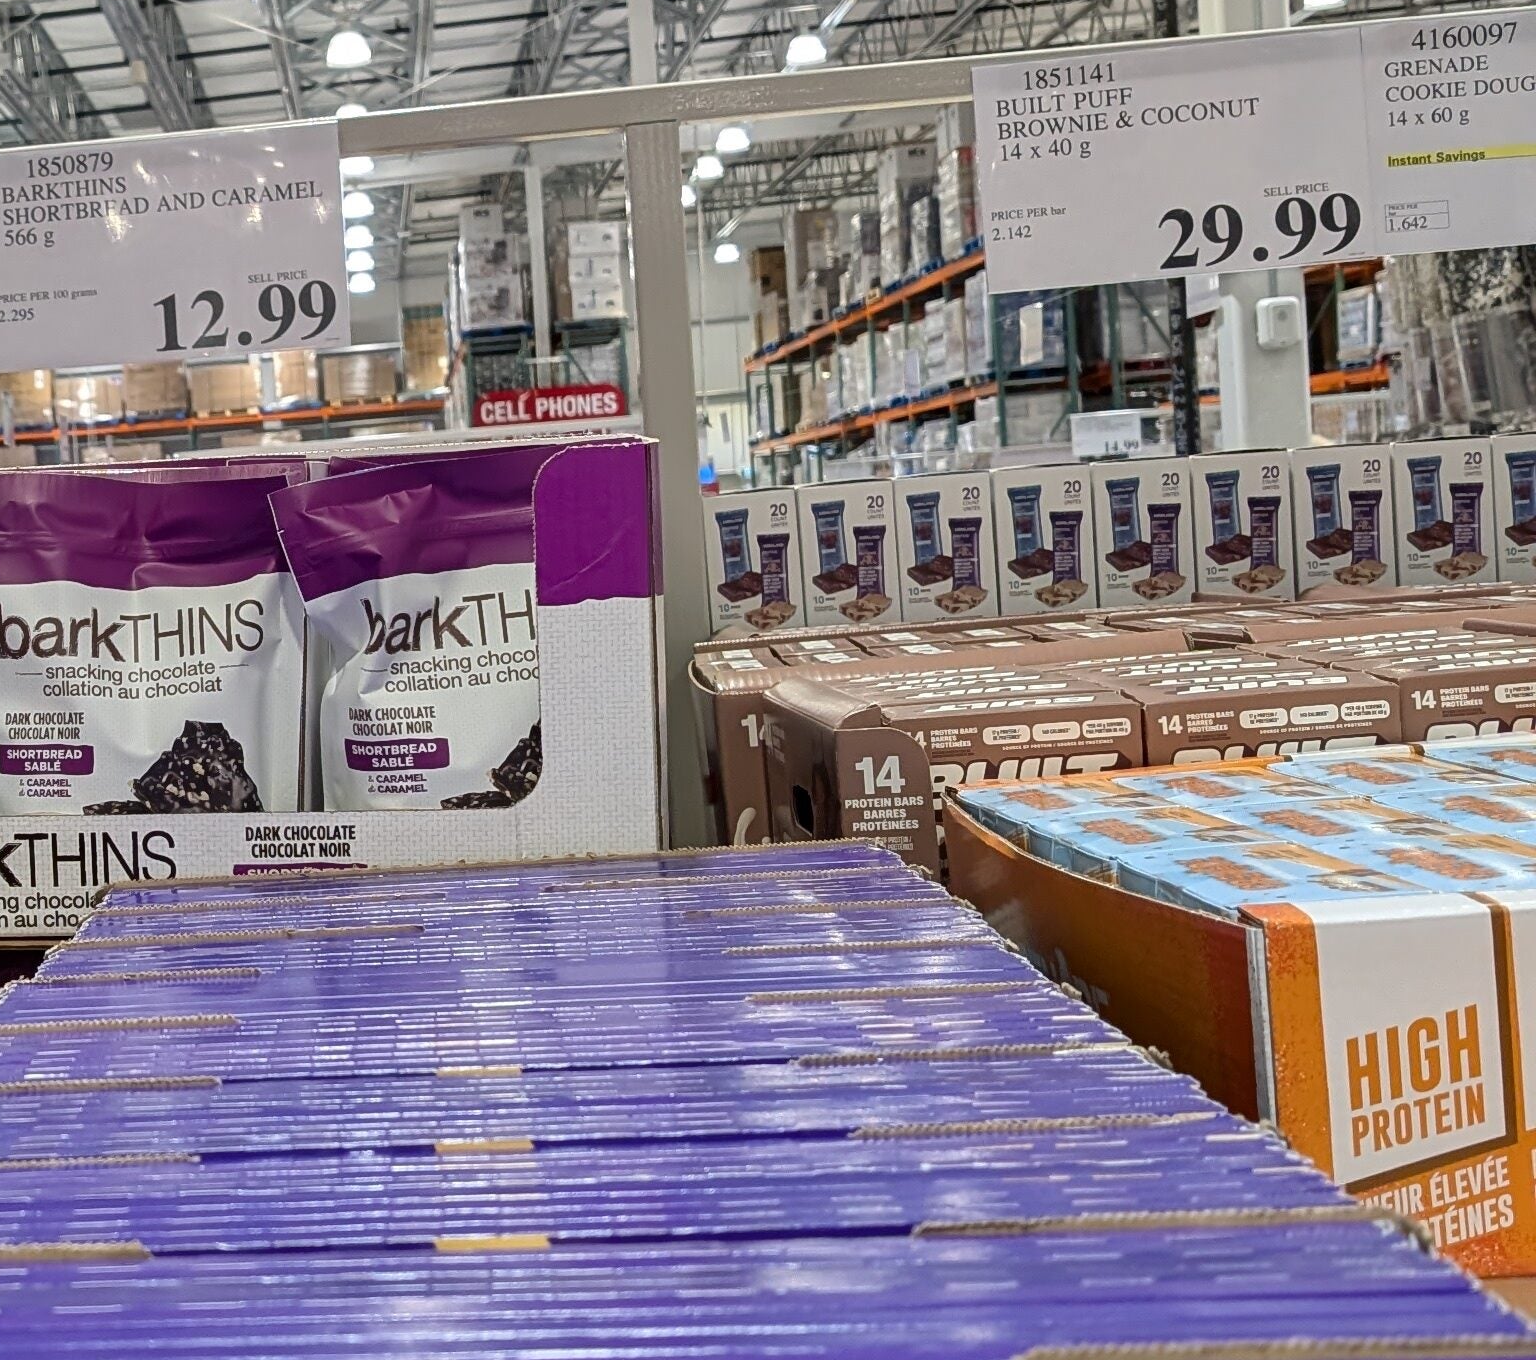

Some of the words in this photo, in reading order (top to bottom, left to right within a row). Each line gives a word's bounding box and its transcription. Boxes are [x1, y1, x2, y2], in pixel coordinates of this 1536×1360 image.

[1411, 21, 1517, 51] 4160097
[1384, 55, 1489, 78] GRENADE
[1023, 62, 1115, 91] 1851141
[1385, 81, 1467, 102] COOKIE
[996, 93, 1065, 118] BUILT
[1074, 87, 1133, 110] PUFF
[998, 113, 1109, 140] BROWNIE
[1115, 110, 1134, 129] &
[1141, 97, 1260, 126] COCONUT
[1388, 110, 1407, 127] 14
[1415, 113, 1424, 125] x
[1431, 106, 1453, 123] 60
[1459, 109, 1470, 125] g
[1000, 144, 1022, 162] 14
[1030, 145, 1041, 158] x
[1048, 138, 1072, 157] 40
[1080, 140, 1091, 158] g
[27, 152, 113, 178] 1850879
[1388, 154, 1432, 167] Instant
[1436, 150, 1486, 163] Savings
[1, 176, 127, 205] BARKTHINS
[157, 192, 205, 213] AND
[212, 180, 323, 208] CARAMEL
[1264, 185, 1292, 198] SELL
[1295, 182, 1329, 195] PRICE
[990, 210, 1024, 221] PRICE
[1026, 208, 1048, 219] PER
[1050, 205, 1066, 218] bar
[1158, 192, 1361, 269] 29.99
[1389, 216, 1427, 232] 1.642
[4, 227, 37, 247] 566
[44, 230, 55, 247] g
[991, 225, 1032, 241] 2.142
[248, 272, 273, 284] SELL
[276, 269, 307, 282] PRICE
[30, 291, 50, 302] PER
[52, 290, 69, 300] 100
[153, 280, 337, 352] 12.99
[480, 398, 532, 424] CELL
[535, 392, 619, 419] PHONES
[1363, 459, 1381, 473] 20
[1464, 452, 1482, 465] 20
[1162, 473, 1180, 486] 20
[1262, 465, 1280, 479] 20
[962, 487, 980, 500] 20
[1064, 480, 1081, 493] 20
[866, 495, 884, 508] 20
[770, 503, 787, 517] 20
[45, 663, 122, 685] snacking
[128, 660, 216, 683] chocolate
[390, 656, 471, 675] snacking
[43, 681, 113, 697] collation
[118, 686, 140, 699] au
[145, 676, 223, 699] chocolat
[385, 675, 462, 693] collation
[468, 673, 490, 686] au
[1411, 689, 1437, 710] 14
[5, 713, 31, 726] DARK
[33, 712, 84, 725] CHOCOLATE
[349, 707, 372, 722] DARK
[375, 706, 436, 721] CHOCOLATE
[353, 722, 402, 736] CHOCOLAT
[406, 721, 433, 734] NOIR
[1157, 715, 1183, 735] 14
[8, 727, 55, 740] CHOCOLAT
[57, 727, 80, 740] NOIR
[7, 749, 82, 760] SHORTBREAD
[352, 743, 437, 756] SHORTBREAD
[24, 760, 61, 772] SABLÉ
[26, 778, 71, 787] CARAMEL
[376, 773, 427, 783] CARAMEL
[855, 755, 906, 795] 14
[26, 789, 71, 797] CARAMEL
[377, 785, 427, 793] CARAMEL
[844, 798, 891, 809] PROTEIN
[894, 796, 924, 806] BARS
[864, 809, 906, 819] BARRES
[245, 826, 281, 841] DARK
[284, 825, 356, 840] CHOCOLATE
[251, 843, 315, 858] CHOCOLAT
[319, 842, 350, 857] NOIR
[14, 915, 37, 928] au
[1346, 1004, 1482, 1111] HIGH
[1351, 1082, 1485, 1157] PROTEIN
[1429, 1155, 1510, 1208] ÉLEVÉE
